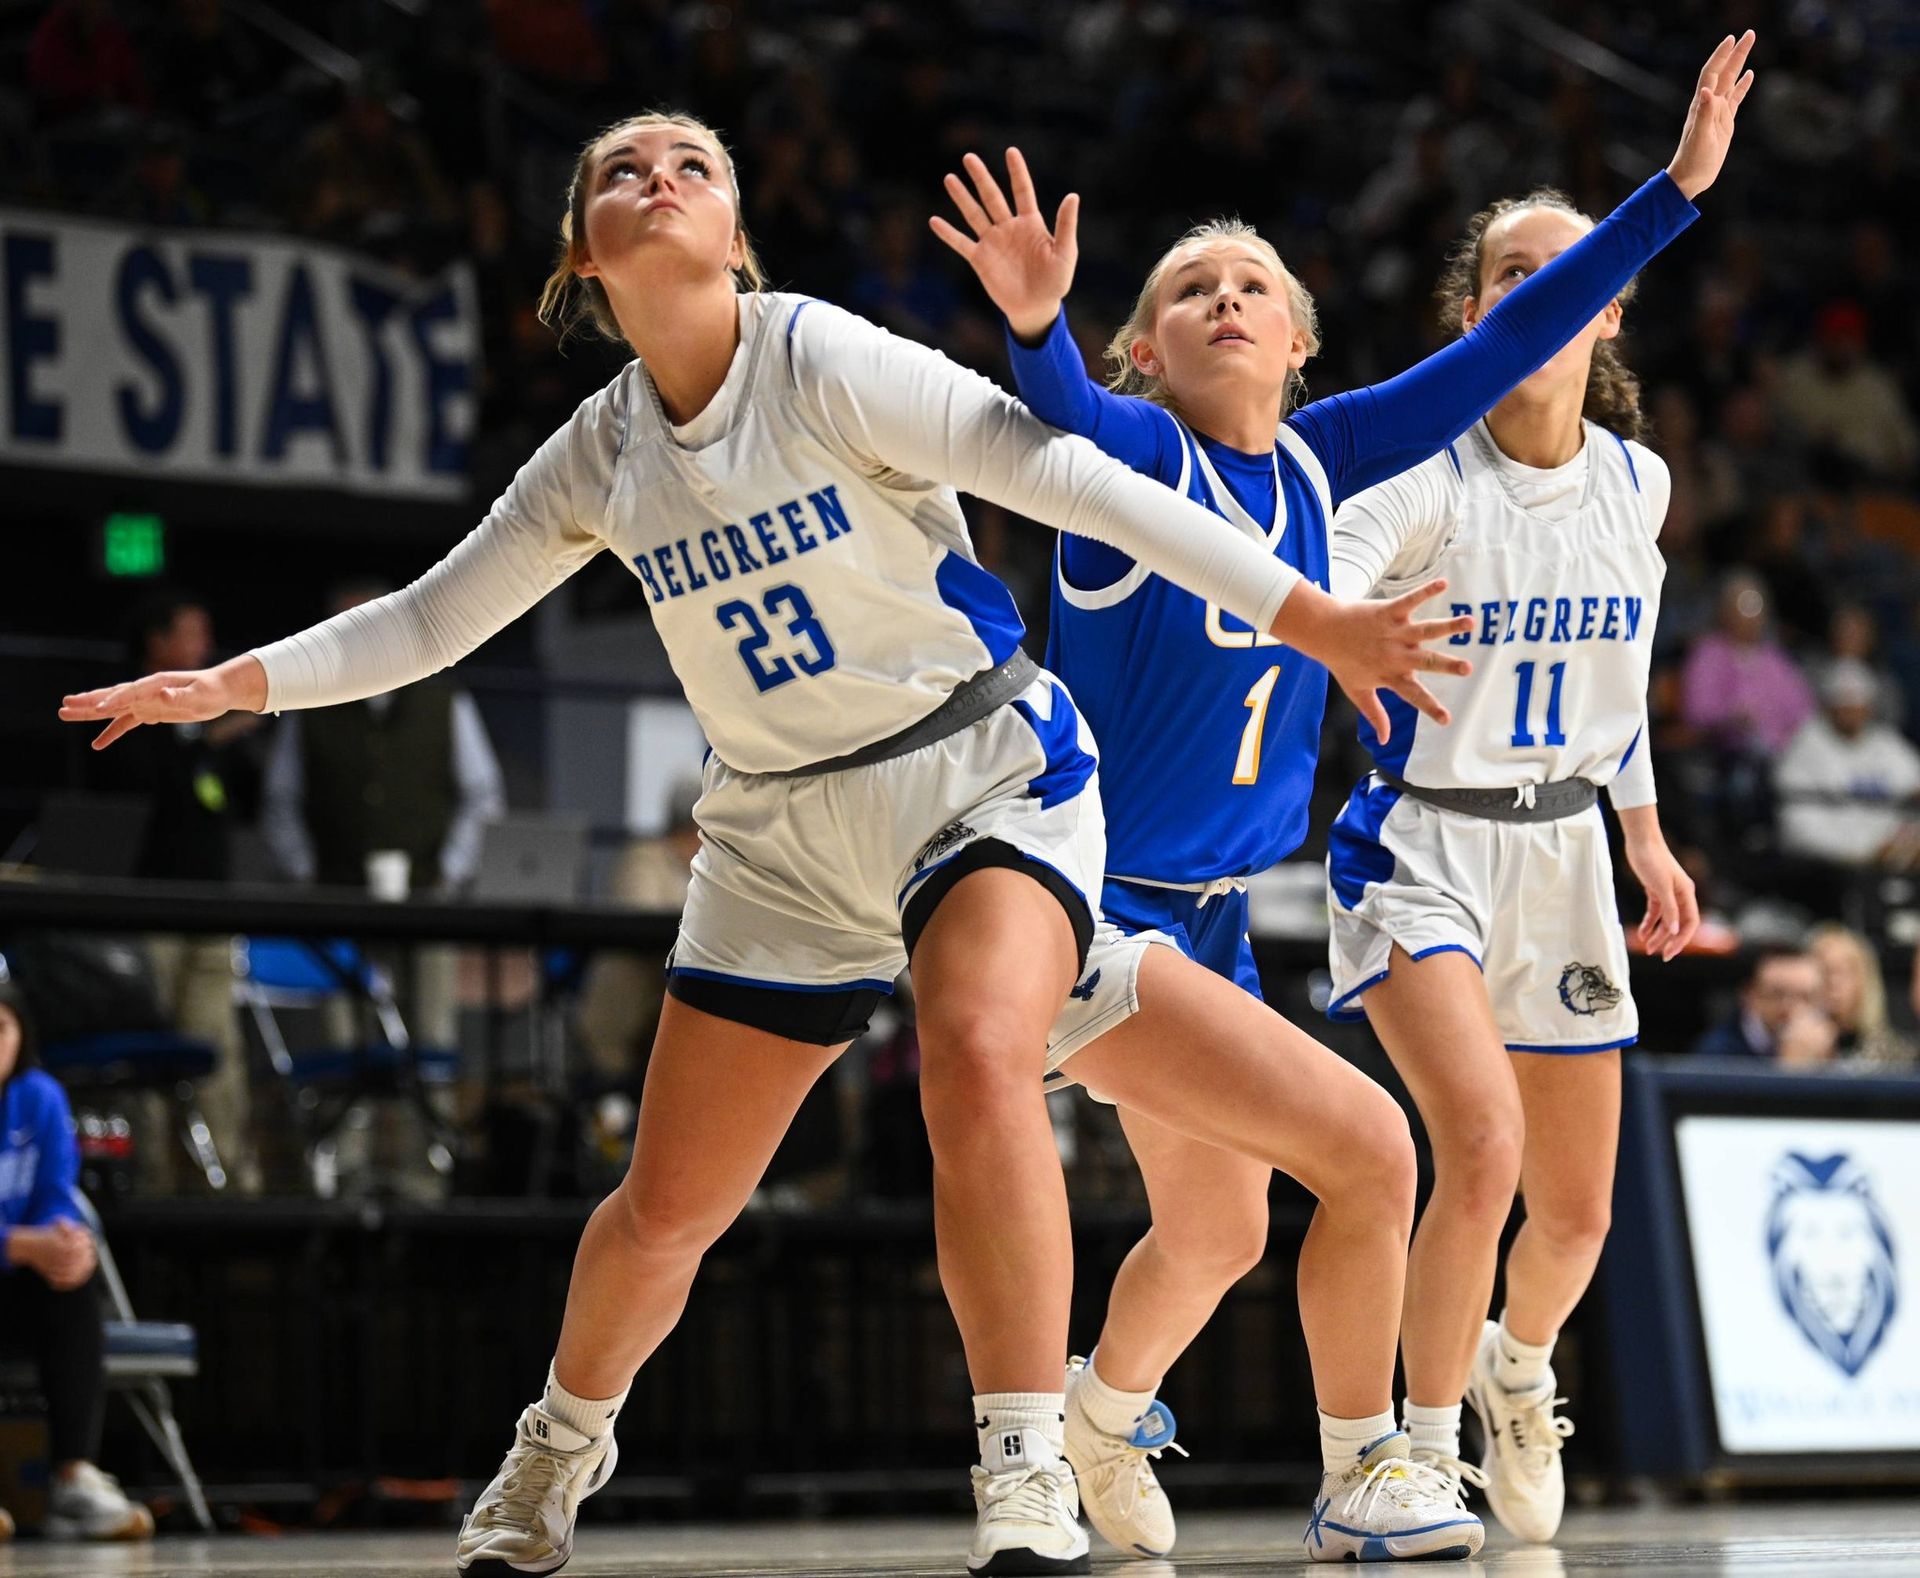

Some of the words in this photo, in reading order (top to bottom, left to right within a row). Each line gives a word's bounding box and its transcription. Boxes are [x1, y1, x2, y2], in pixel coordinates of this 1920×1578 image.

[113, 243, 473, 474] STATE
[633, 484, 852, 602] BELGREEN
[715, 581, 838, 694] 23
[1449, 596, 1642, 645] BELGREEN
[1232, 665, 1281, 785] 1
[1511, 661, 1567, 747] 11
